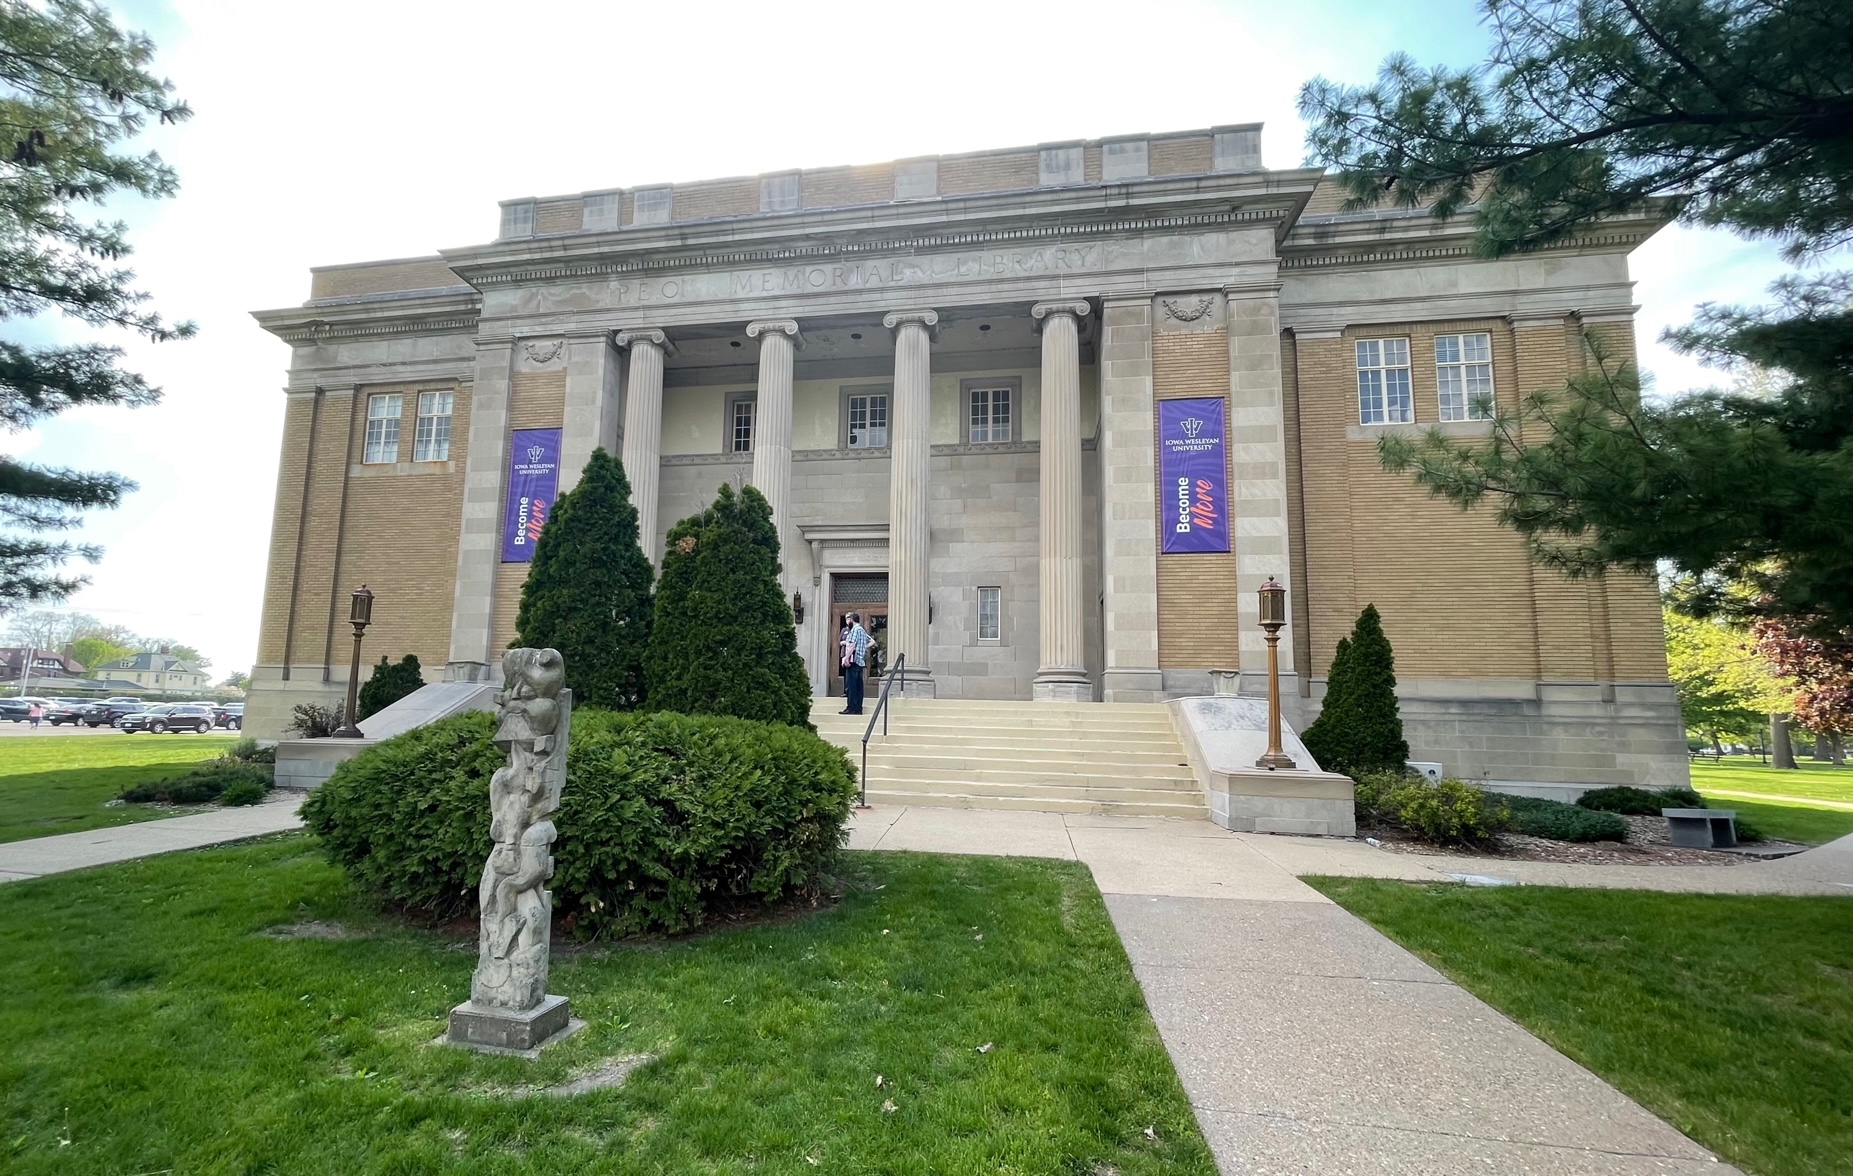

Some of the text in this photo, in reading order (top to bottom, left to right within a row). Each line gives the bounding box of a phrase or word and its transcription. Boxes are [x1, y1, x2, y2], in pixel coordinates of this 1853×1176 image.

[733, 262, 905, 295] MEMORIAL
[1172, 444, 1213, 452] UNIVERSITY
[1185, 437, 1220, 445] WESLEYAN
[514, 496, 529, 545] Become
[526, 498, 546, 541] More
[1176, 476, 1191, 533] Become
[1190, 476, 1218, 529] More
